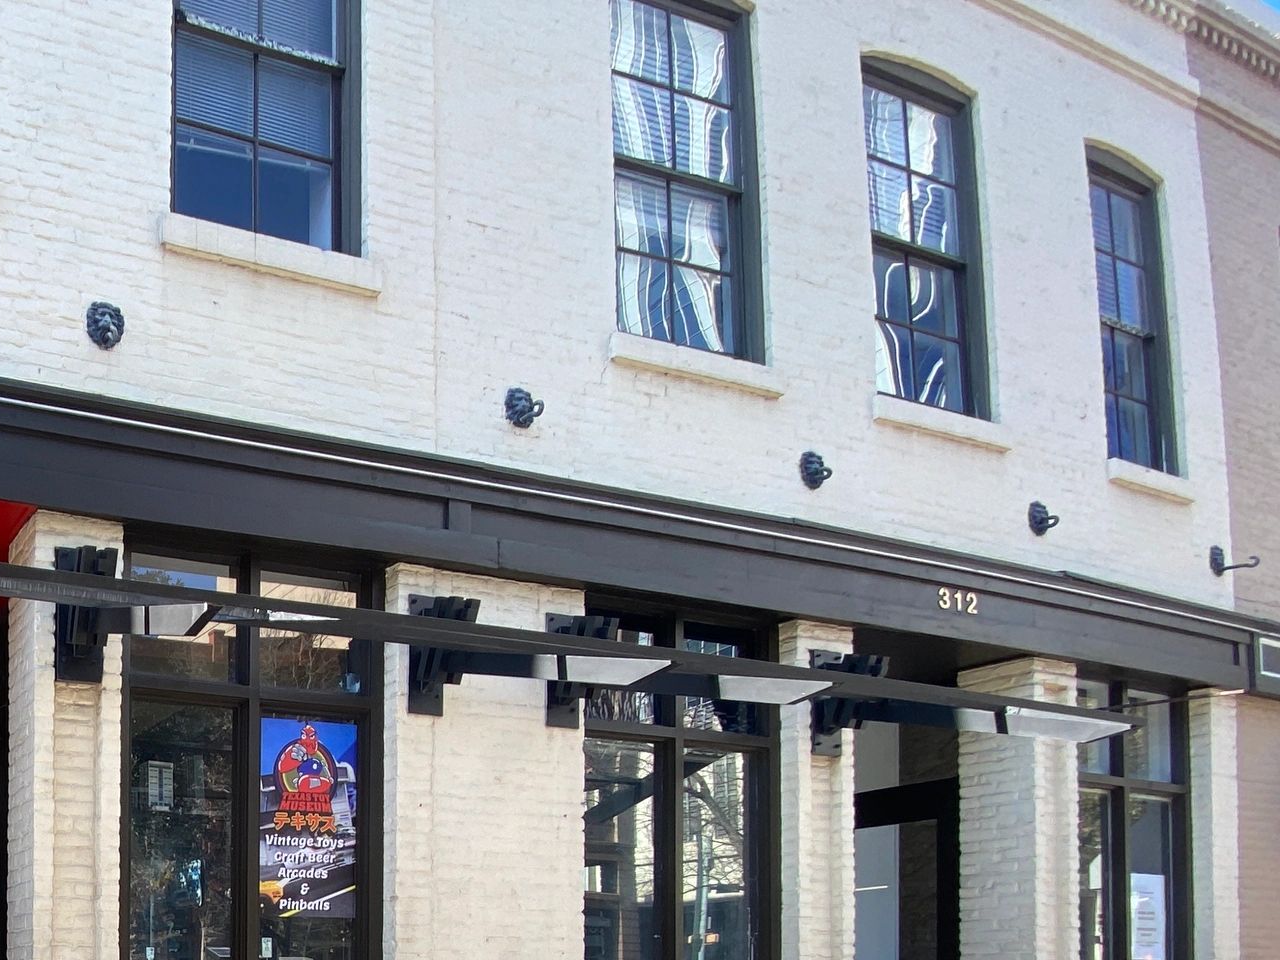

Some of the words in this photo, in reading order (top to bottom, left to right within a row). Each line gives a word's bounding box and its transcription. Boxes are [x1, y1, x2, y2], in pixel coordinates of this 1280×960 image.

[938, 587, 978, 615] 312
[282, 792, 311, 802] TEXAS
[312, 793, 331, 803] TOY
[279, 801, 332, 812] MUSEUM
[274, 811, 337, 833] テキサス
[265, 834, 314, 848] Vintage
[315, 837, 344, 848] Toys
[274, 852, 306, 863] Craft
[308, 852, 336, 863] Beer
[277, 867, 329, 879] Arcades
[300, 883, 310, 895] &
[279, 898, 331, 911] Pinballs
